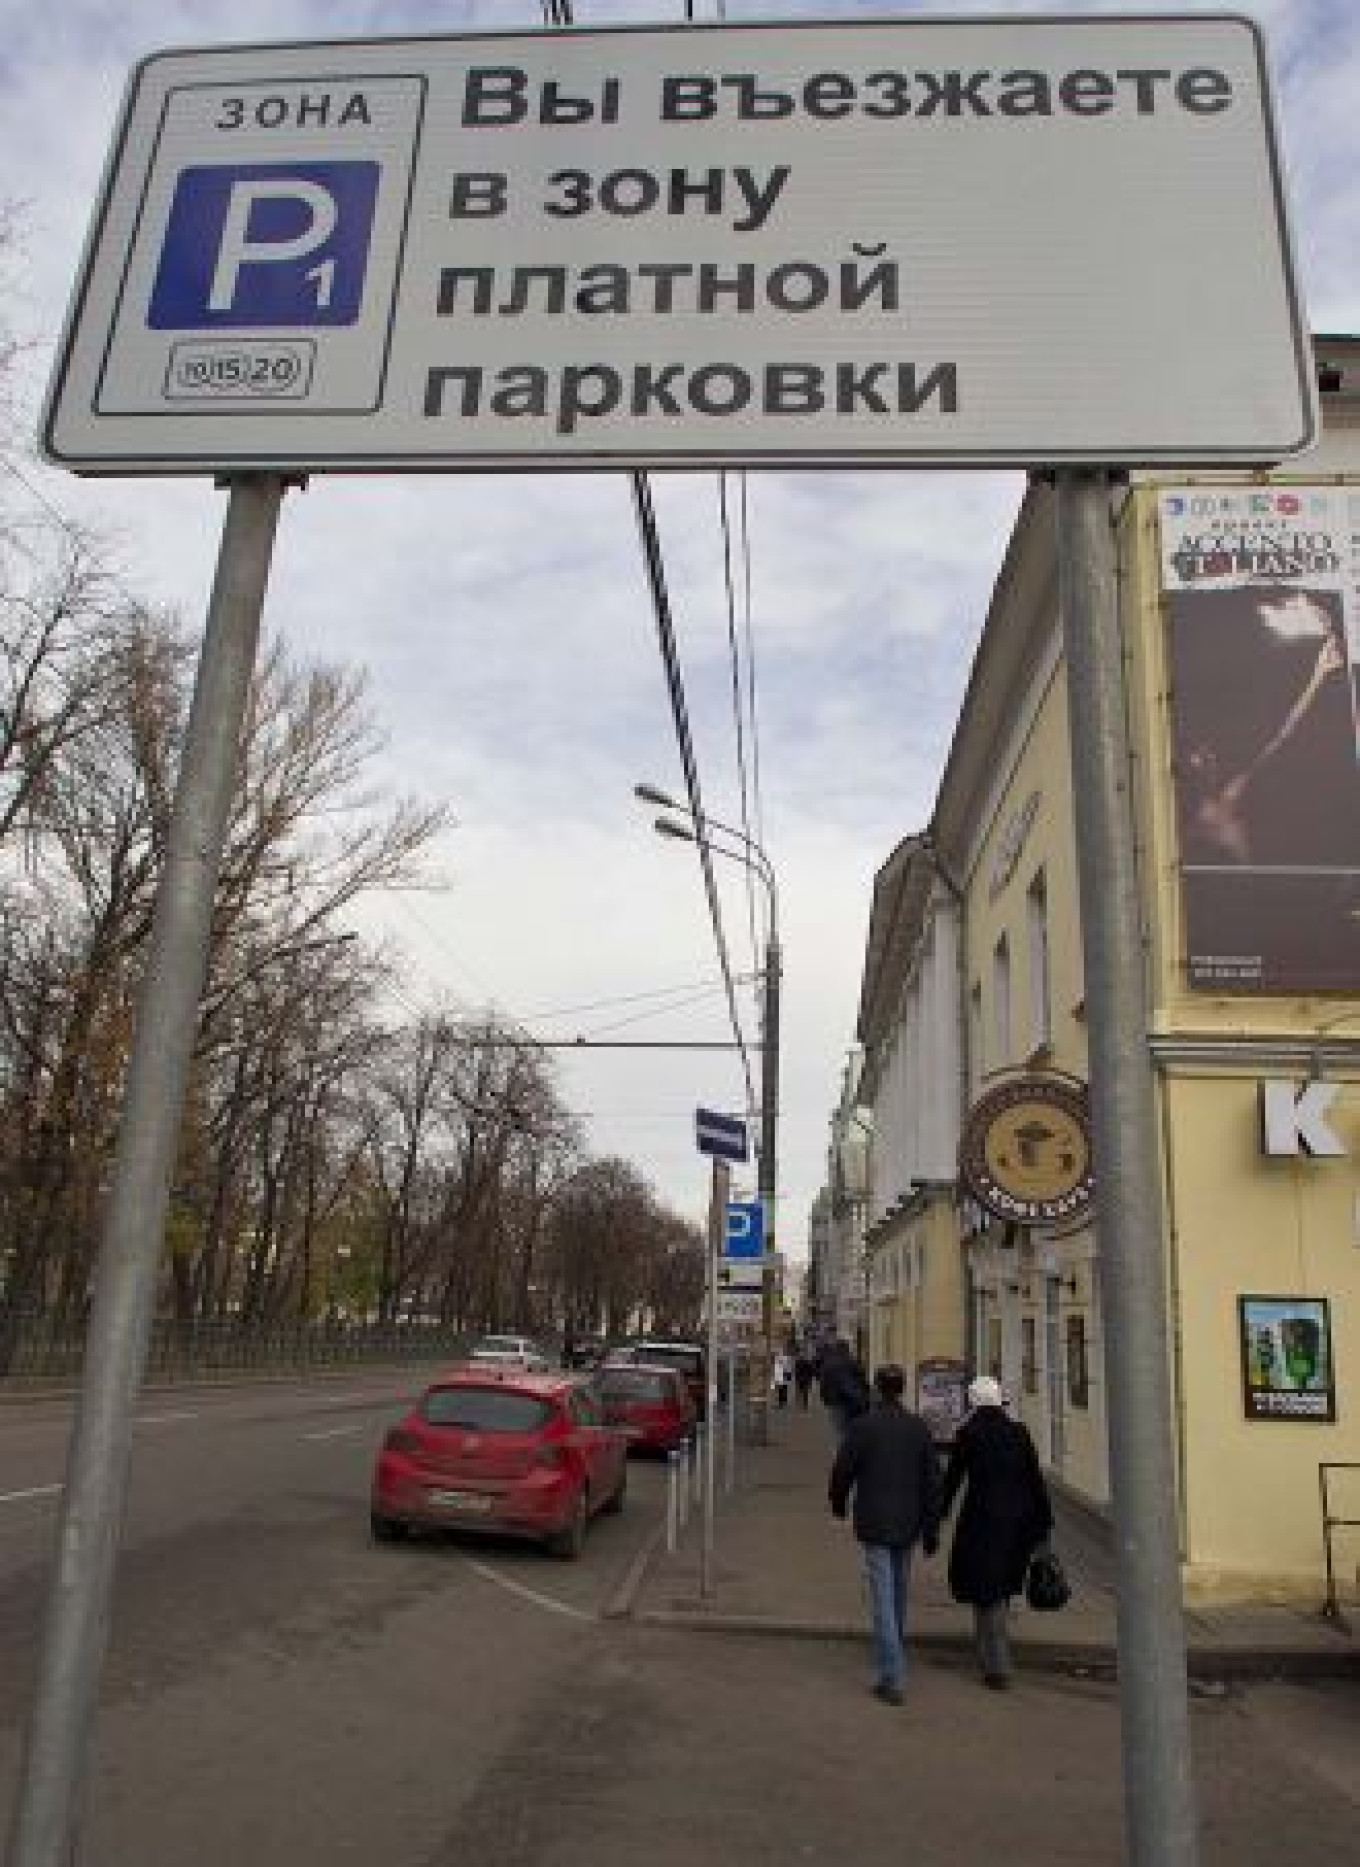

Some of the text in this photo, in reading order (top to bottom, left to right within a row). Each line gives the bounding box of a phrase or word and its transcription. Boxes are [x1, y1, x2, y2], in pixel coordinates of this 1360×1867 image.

[216, 93, 371, 130] ЗОНА
[462, 67, 1232, 126] Вы въезжаете
[449, 166, 791, 231] в зону
[304, 261, 336, 306] 1
[437, 243, 898, 316] платной
[251, 358, 292, 380] 20
[424, 363, 957, 433] парковки
